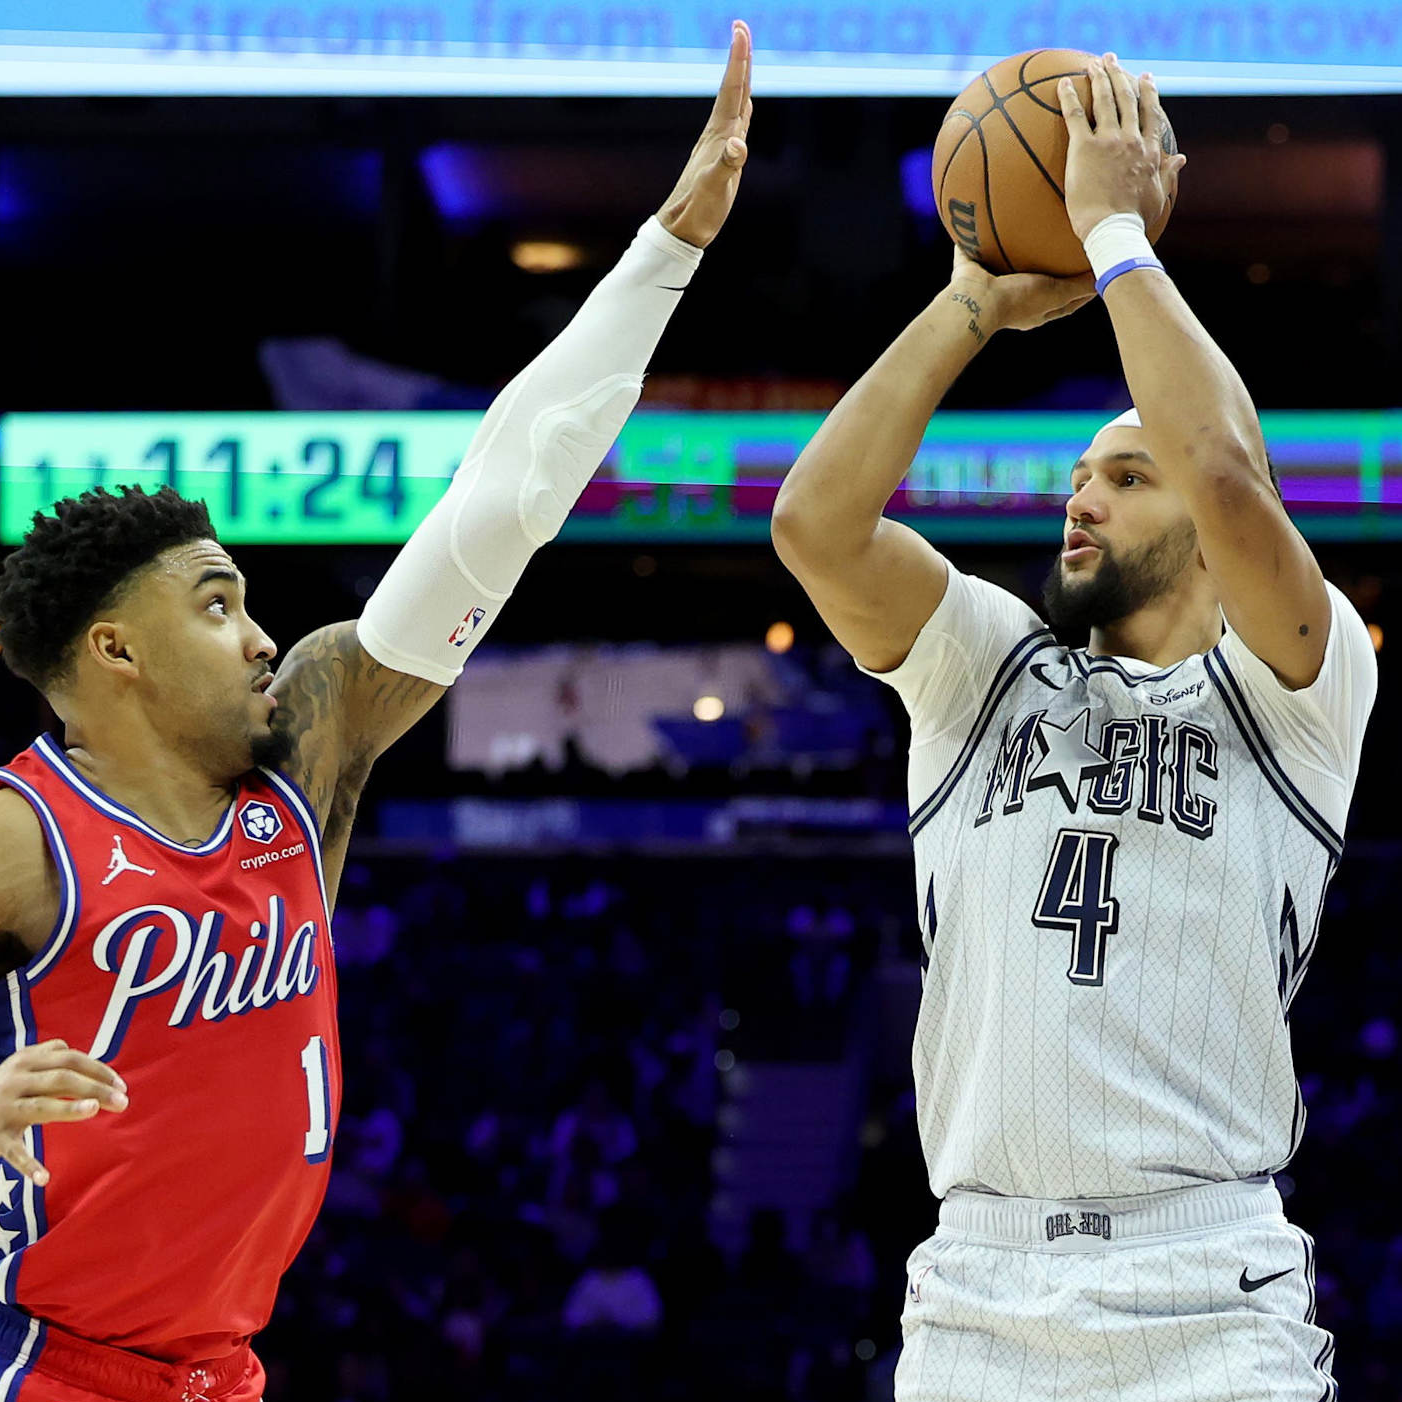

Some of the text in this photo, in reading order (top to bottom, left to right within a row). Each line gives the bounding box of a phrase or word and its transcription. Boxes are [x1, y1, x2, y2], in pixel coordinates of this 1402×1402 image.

[146, 437, 411, 520] 11:24
[974, 708, 1218, 840] MGIC
[240, 843, 305, 869] crypto.com
[1031, 828, 1119, 986] 4
[89, 894, 319, 1060] Phila
[301, 1035, 332, 1164] 1
